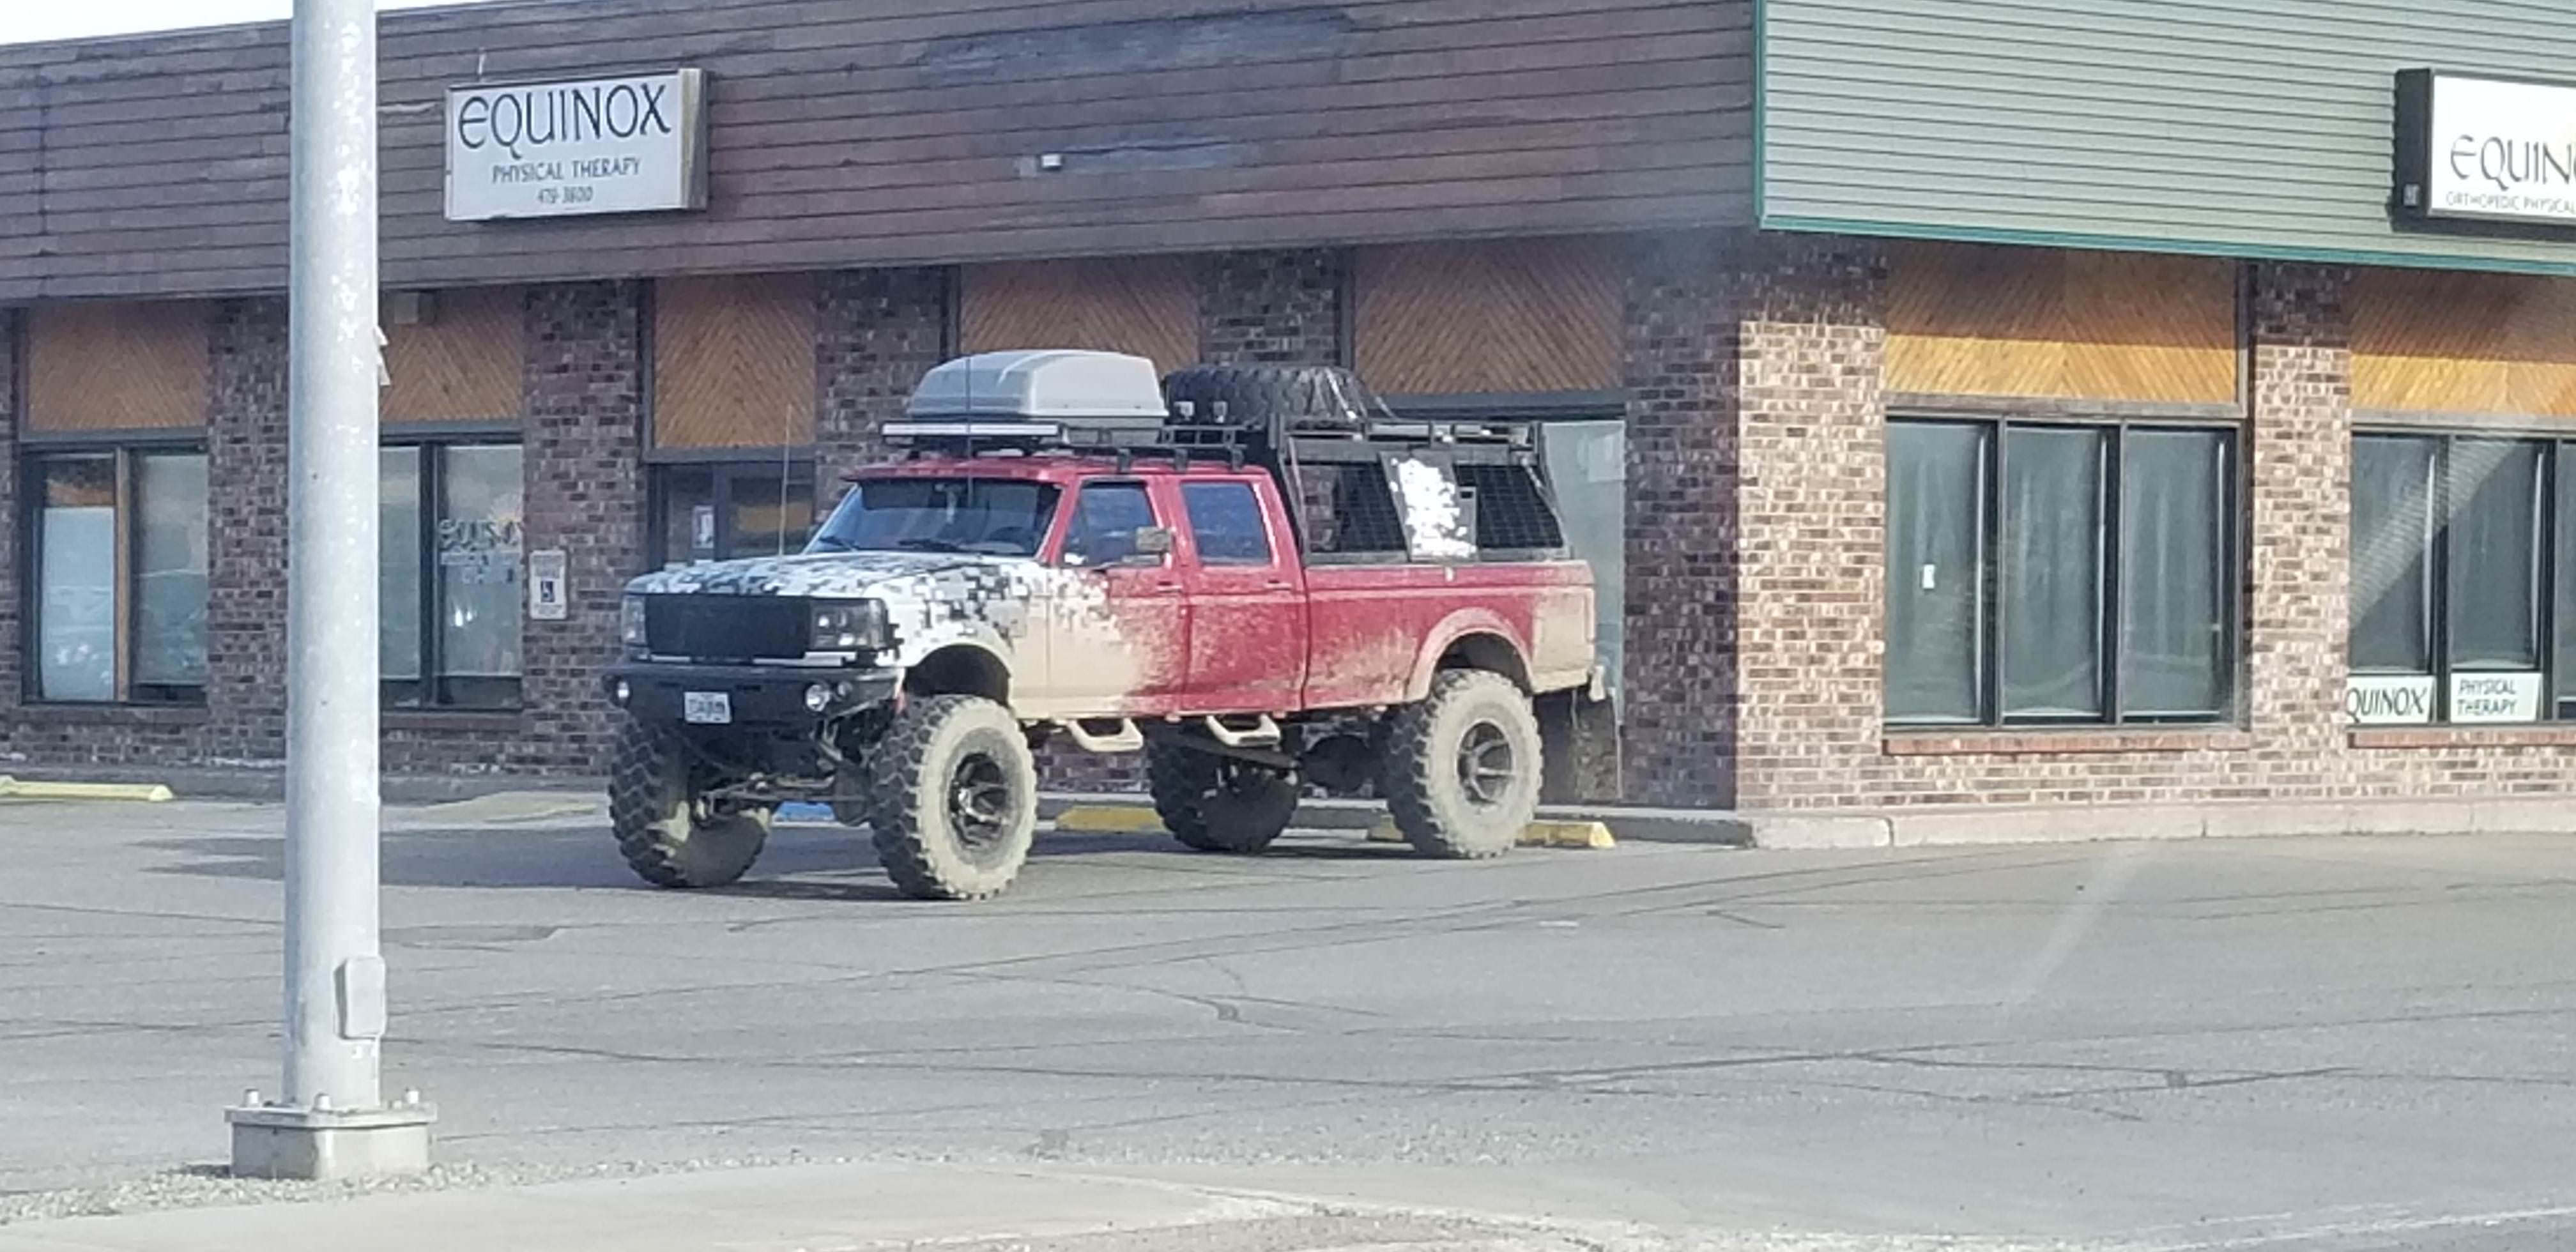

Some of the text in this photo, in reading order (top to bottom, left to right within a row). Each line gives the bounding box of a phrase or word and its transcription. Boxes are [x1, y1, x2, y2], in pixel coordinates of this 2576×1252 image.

[458, 83, 671, 160] EQUINOX
[492, 157, 641, 183] PHYSICAL THERAPY
[2450, 135, 2576, 192] EQUIN
[2458, 679, 2517, 695] PHYSICAL
[2457, 699, 2517, 716] THERAPY
